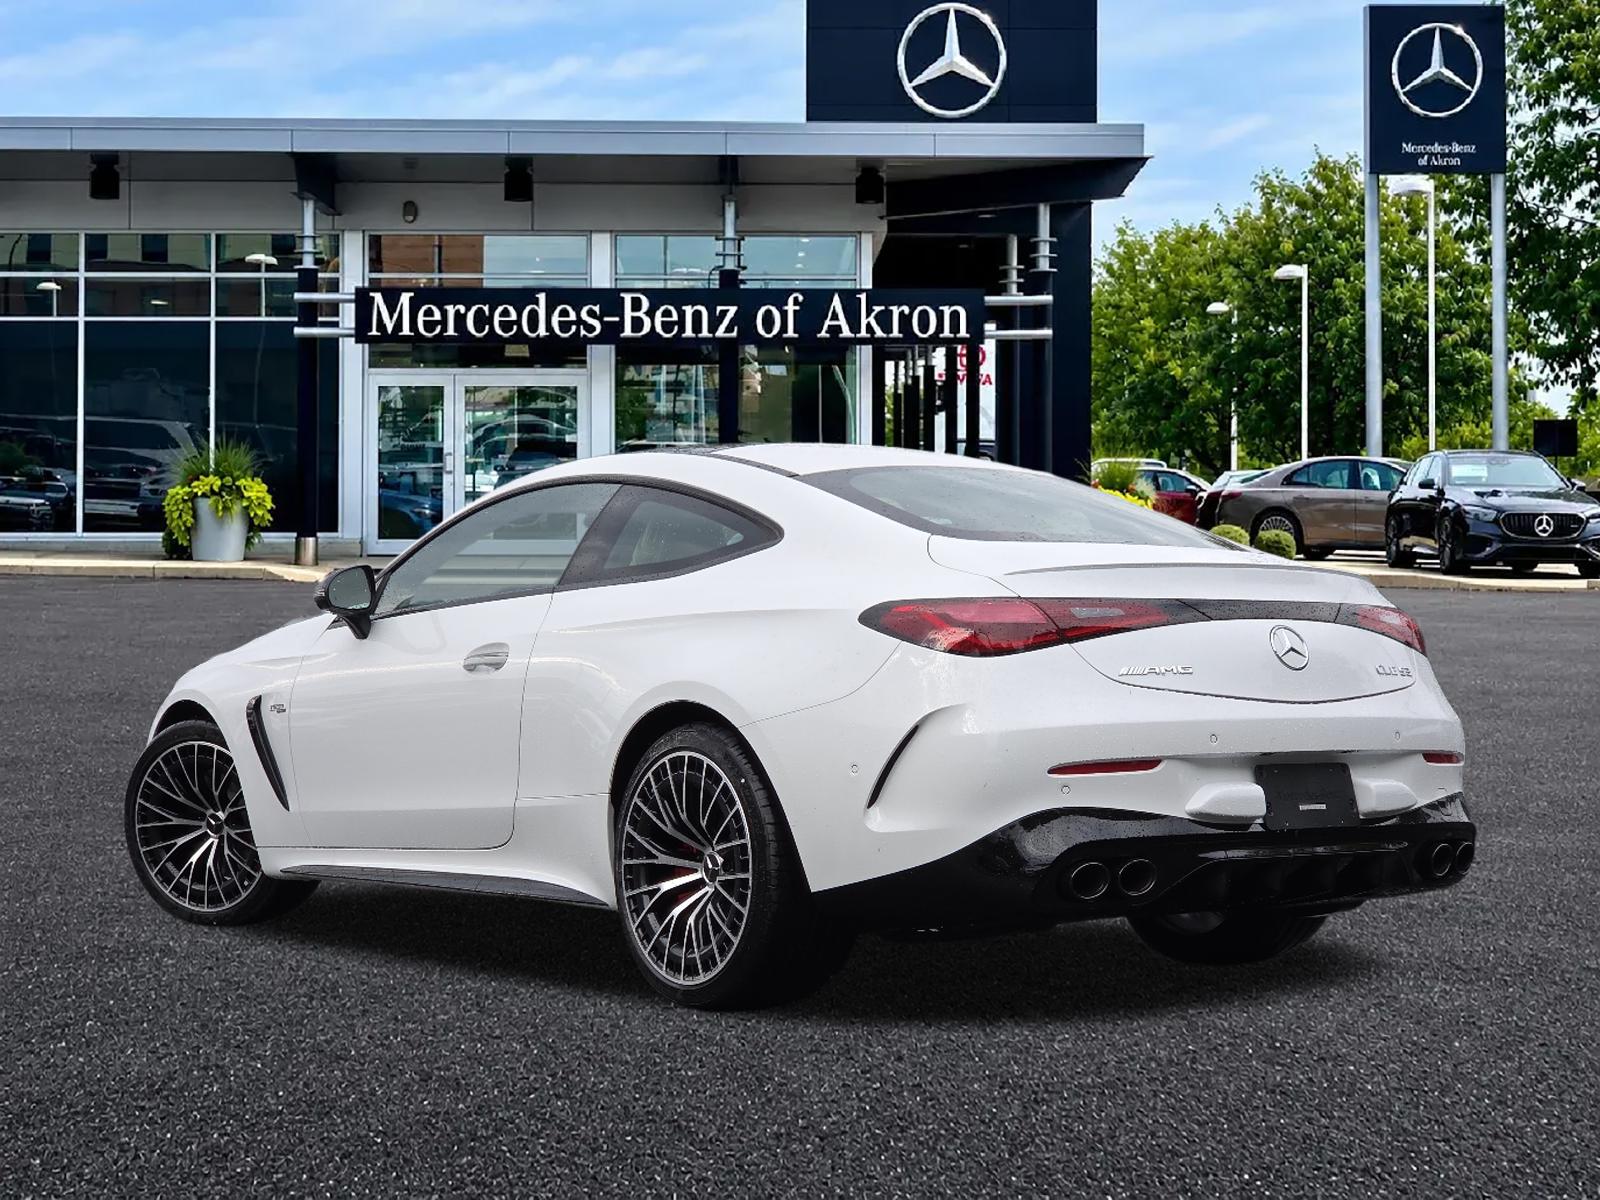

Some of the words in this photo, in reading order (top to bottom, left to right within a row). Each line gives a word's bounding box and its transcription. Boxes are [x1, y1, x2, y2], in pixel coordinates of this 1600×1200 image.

[1401, 141, 1476, 154] Mercedes-Benz
[1417, 154, 1429, 166] of
[1429, 154, 1461, 166] Akron
[367, 291, 738, 338] Mercedes-Benz
[755, 291, 804, 338] of
[816, 291, 971, 339] Akron
[1142, 664, 1193, 676] AMG
